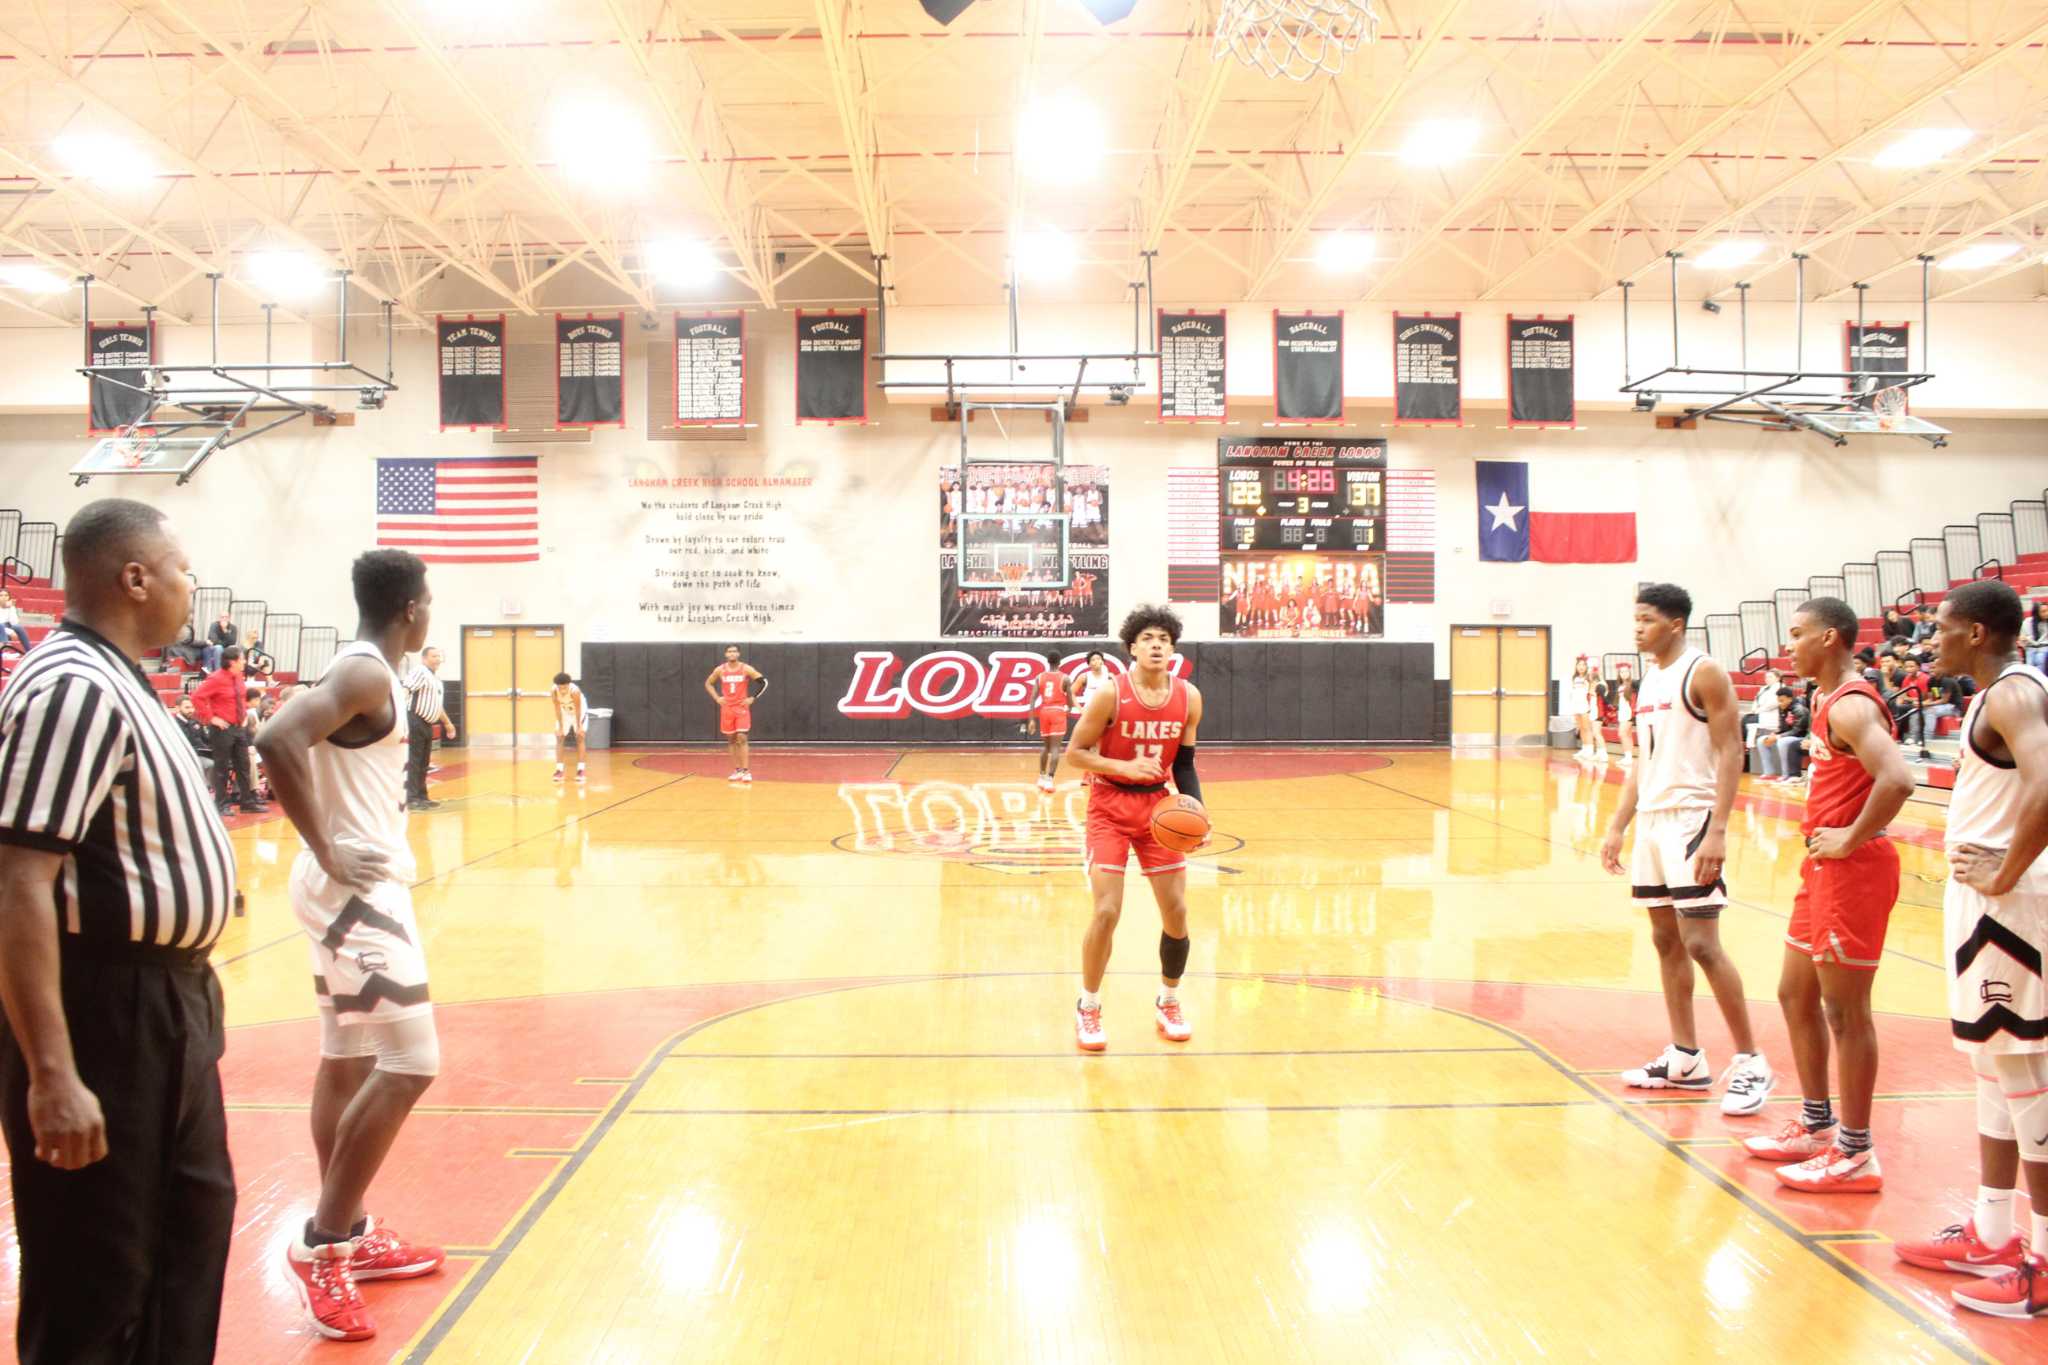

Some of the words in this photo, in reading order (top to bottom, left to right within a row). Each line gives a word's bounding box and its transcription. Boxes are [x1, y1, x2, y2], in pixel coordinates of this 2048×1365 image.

[689, 323, 727, 335] FOOTBALL
[811, 321, 849, 334] FOOTBALL
[1171, 320, 1212, 334] BASEBALL
[1289, 321, 1328, 334] BASEBALL
[1226, 446, 1289, 458] LANGHAM
[1294, 446, 1336, 458] CREEK
[1339, 447, 1381, 458] LOBOS
[1229, 470, 1260, 481] LOBOS
[672, 478, 698, 487] CREEK
[726, 478, 760, 487] SCHOOL
[1297, 497, 1309, 513] 3
[958, 630, 1003, 638] PRACTICE
[1007, 630, 1028, 638] LIKE
[1042, 630, 1089, 638] CHAMPION
[1044, 681, 1054, 698] 2
[1121, 720, 1183, 739] LAKES
